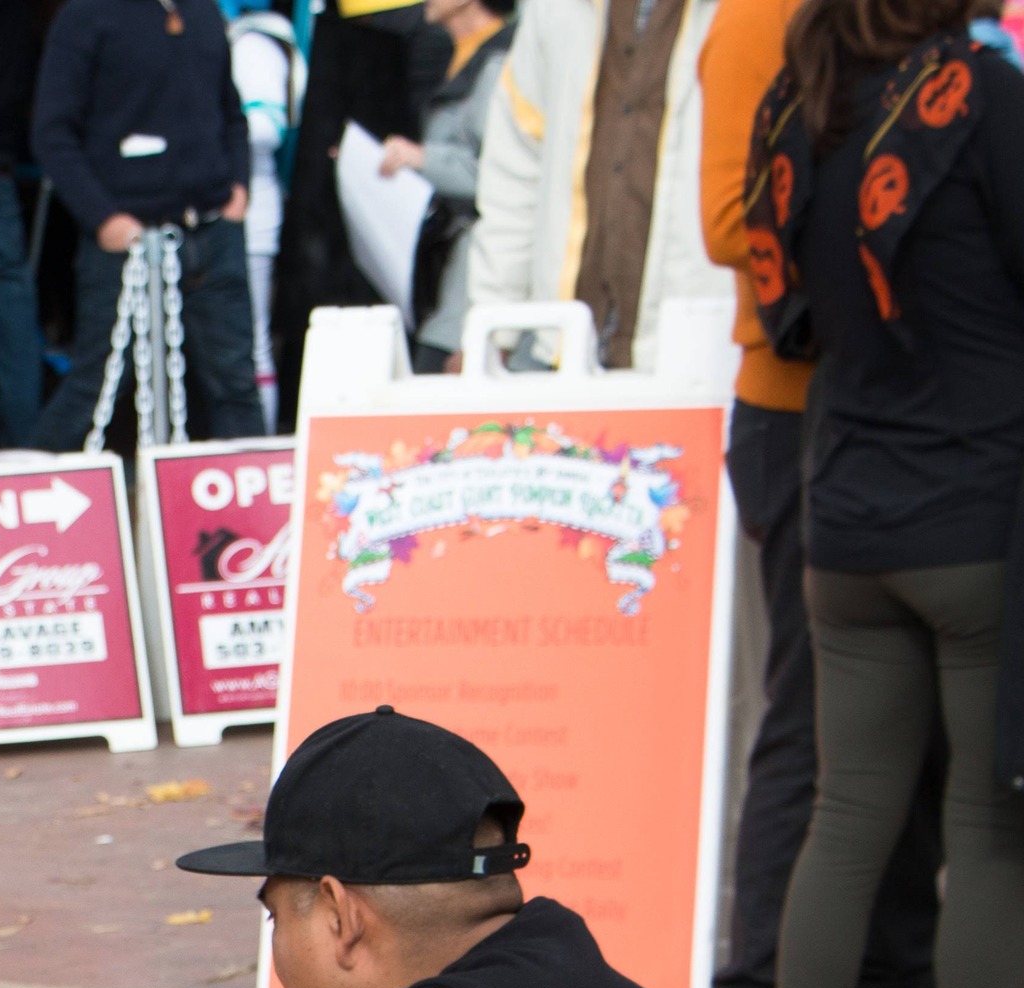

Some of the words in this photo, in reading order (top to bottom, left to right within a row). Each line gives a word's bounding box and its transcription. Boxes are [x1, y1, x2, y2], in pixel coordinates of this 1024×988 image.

[191, 463, 294, 511] OPE
[353, 616, 531, 648] ENTERTAINMENT
[537, 614, 652, 648] SCHEDULE
